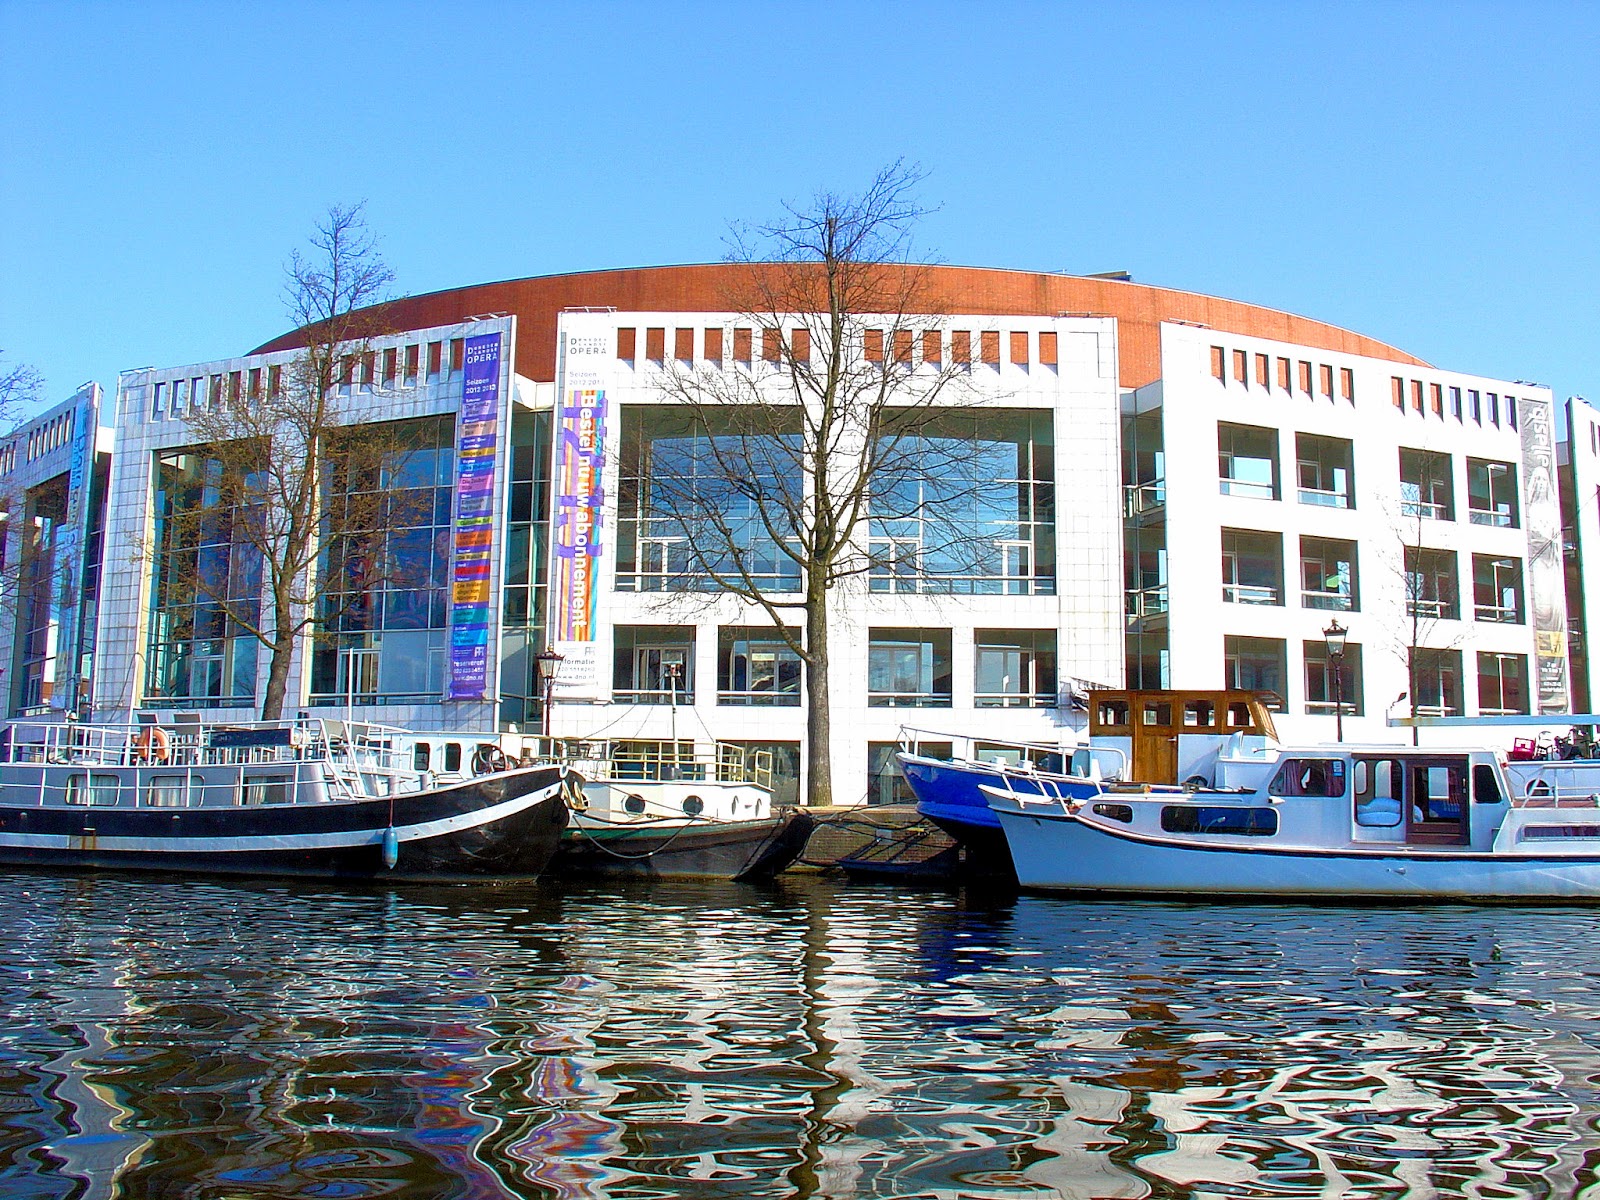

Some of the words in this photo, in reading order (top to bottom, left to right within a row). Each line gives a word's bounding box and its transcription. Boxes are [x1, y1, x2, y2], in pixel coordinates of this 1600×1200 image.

[467, 353, 497, 364] OPERA
[570, 347, 607, 355] OPERA
[466, 378, 490, 386] Seizoen
[466, 386, 481, 394] 2012
[578, 395, 597, 453] Bestel
[578, 455, 591, 478] nu
[576, 482, 590, 508] uw
[571, 511, 593, 628] abonnement
